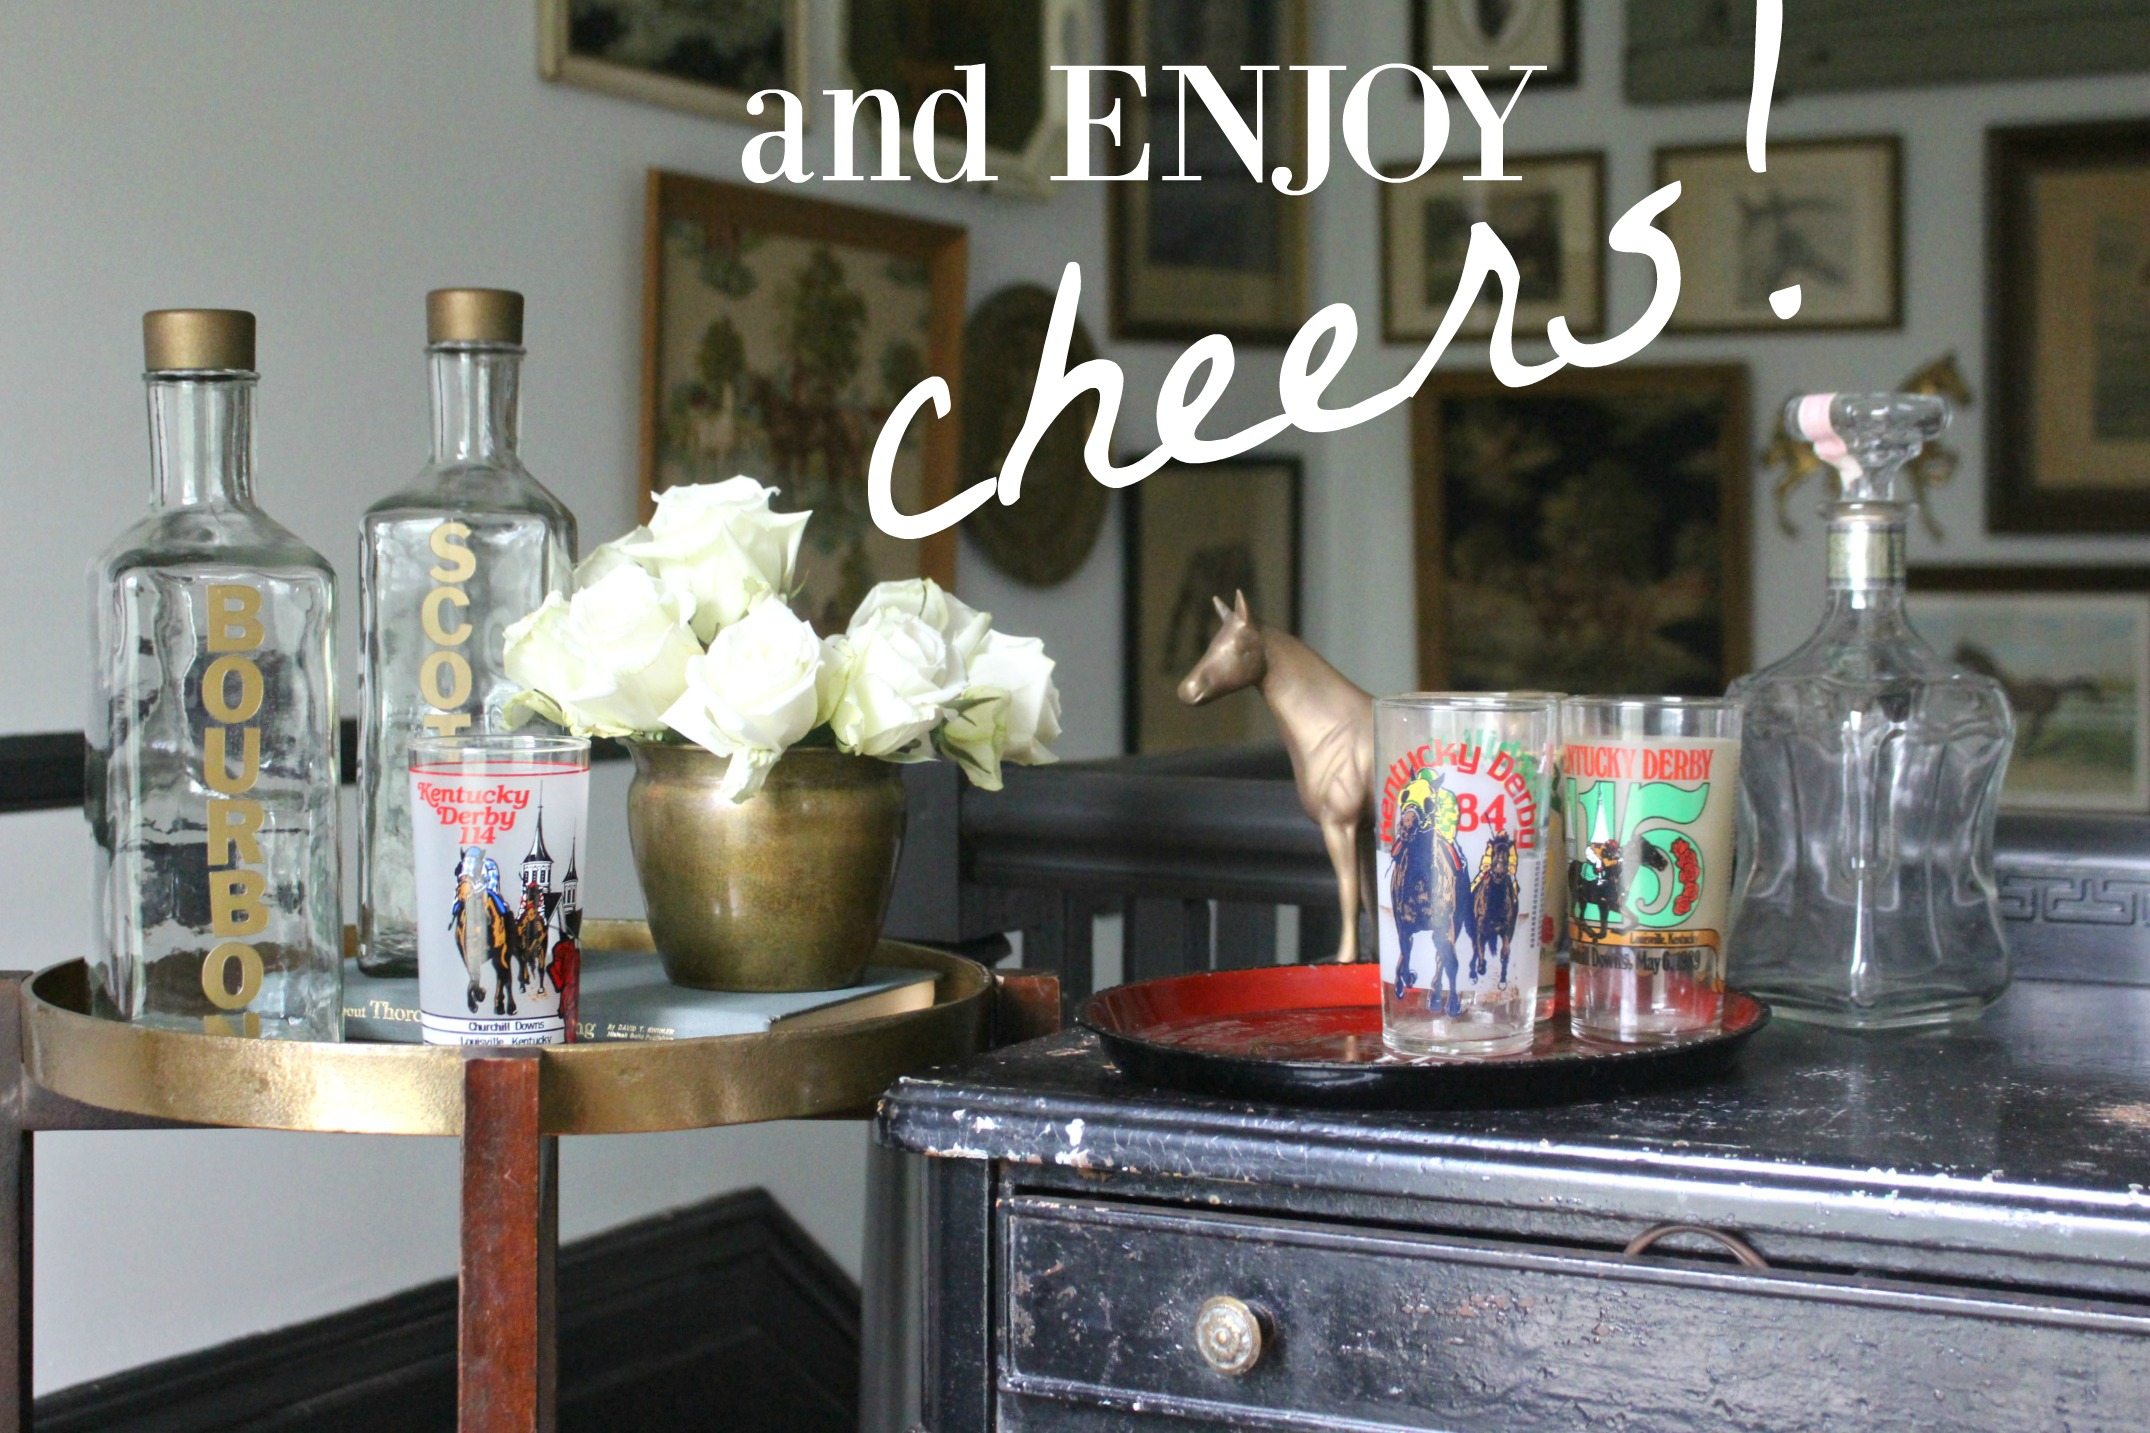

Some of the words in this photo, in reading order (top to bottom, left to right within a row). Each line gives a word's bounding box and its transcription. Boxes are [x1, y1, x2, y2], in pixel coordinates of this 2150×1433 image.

[1641, 748, 1715, 781] DERBY
[417, 781, 531, 810] Kentucky
[1379, 738, 1482, 843] Kentucky
[1486, 750, 1538, 849] Derby
[436, 806, 518, 832] Derby
[1456, 792, 1508, 833] 84
[459, 825, 498, 845] 114
[1636, 950, 1661, 975] May
[468, 1021, 511, 1032] Churchill
[514, 1020, 546, 1031] Downs
